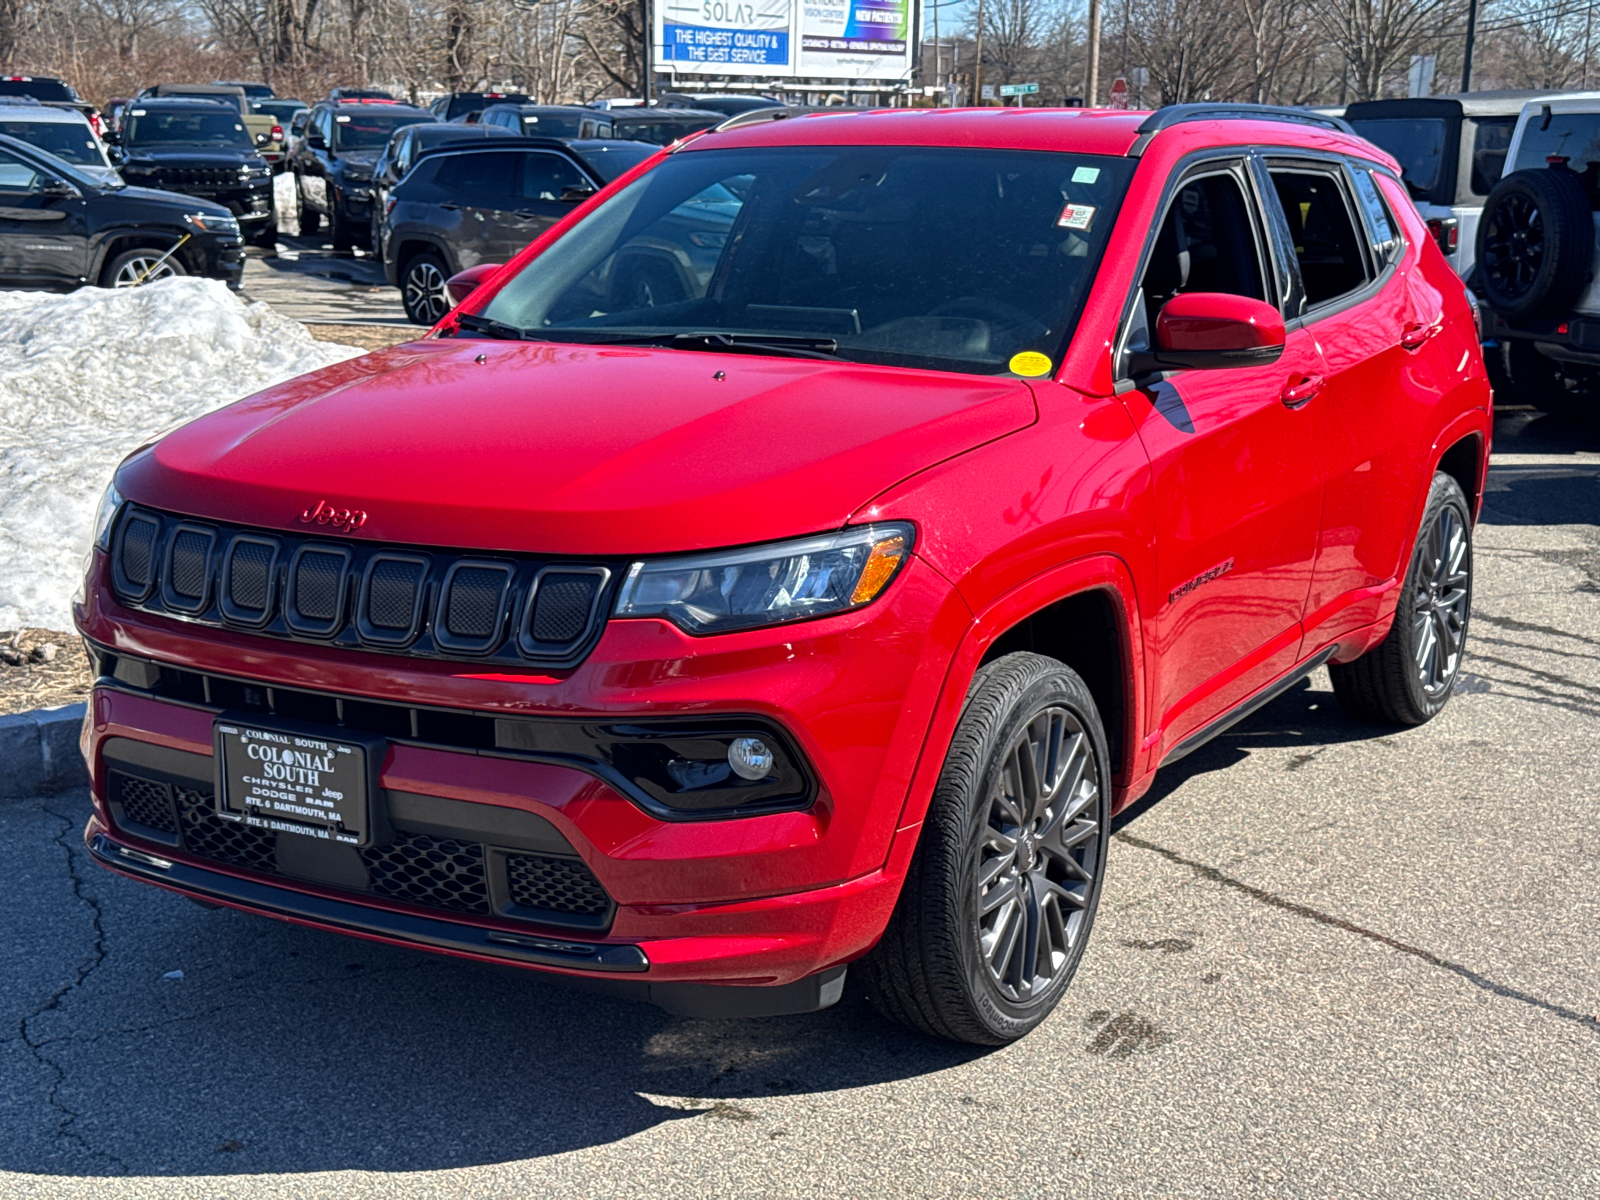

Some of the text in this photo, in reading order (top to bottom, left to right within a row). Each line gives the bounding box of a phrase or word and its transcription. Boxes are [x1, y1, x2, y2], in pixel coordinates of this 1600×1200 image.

[702, 2, 754, 24] SOLAR
[674, 28, 778, 49] THE HIGHEST QUALITY &
[687, 45, 767, 63] THE BEST SERVICE
[301, 499, 368, 534] Jeep
[245, 729, 292, 745] COLONIAL
[294, 738, 329, 751] SOUTH
[246, 743, 335, 774] COLONIAL
[242, 775, 314, 795] CHRYSLER
[263, 761, 320, 787] SOUTH
[251, 786, 335, 809] DODGE RAM
[321, 787, 344, 801] Jeep
[245, 796, 342, 822] RTE. 6 DARTMOUTH, MA
[246, 816, 263, 828] RTE.
[263, 820, 269, 828] 6
[270, 821, 317, 839] DARTMOUTH,
[317, 829, 330, 840] MA
